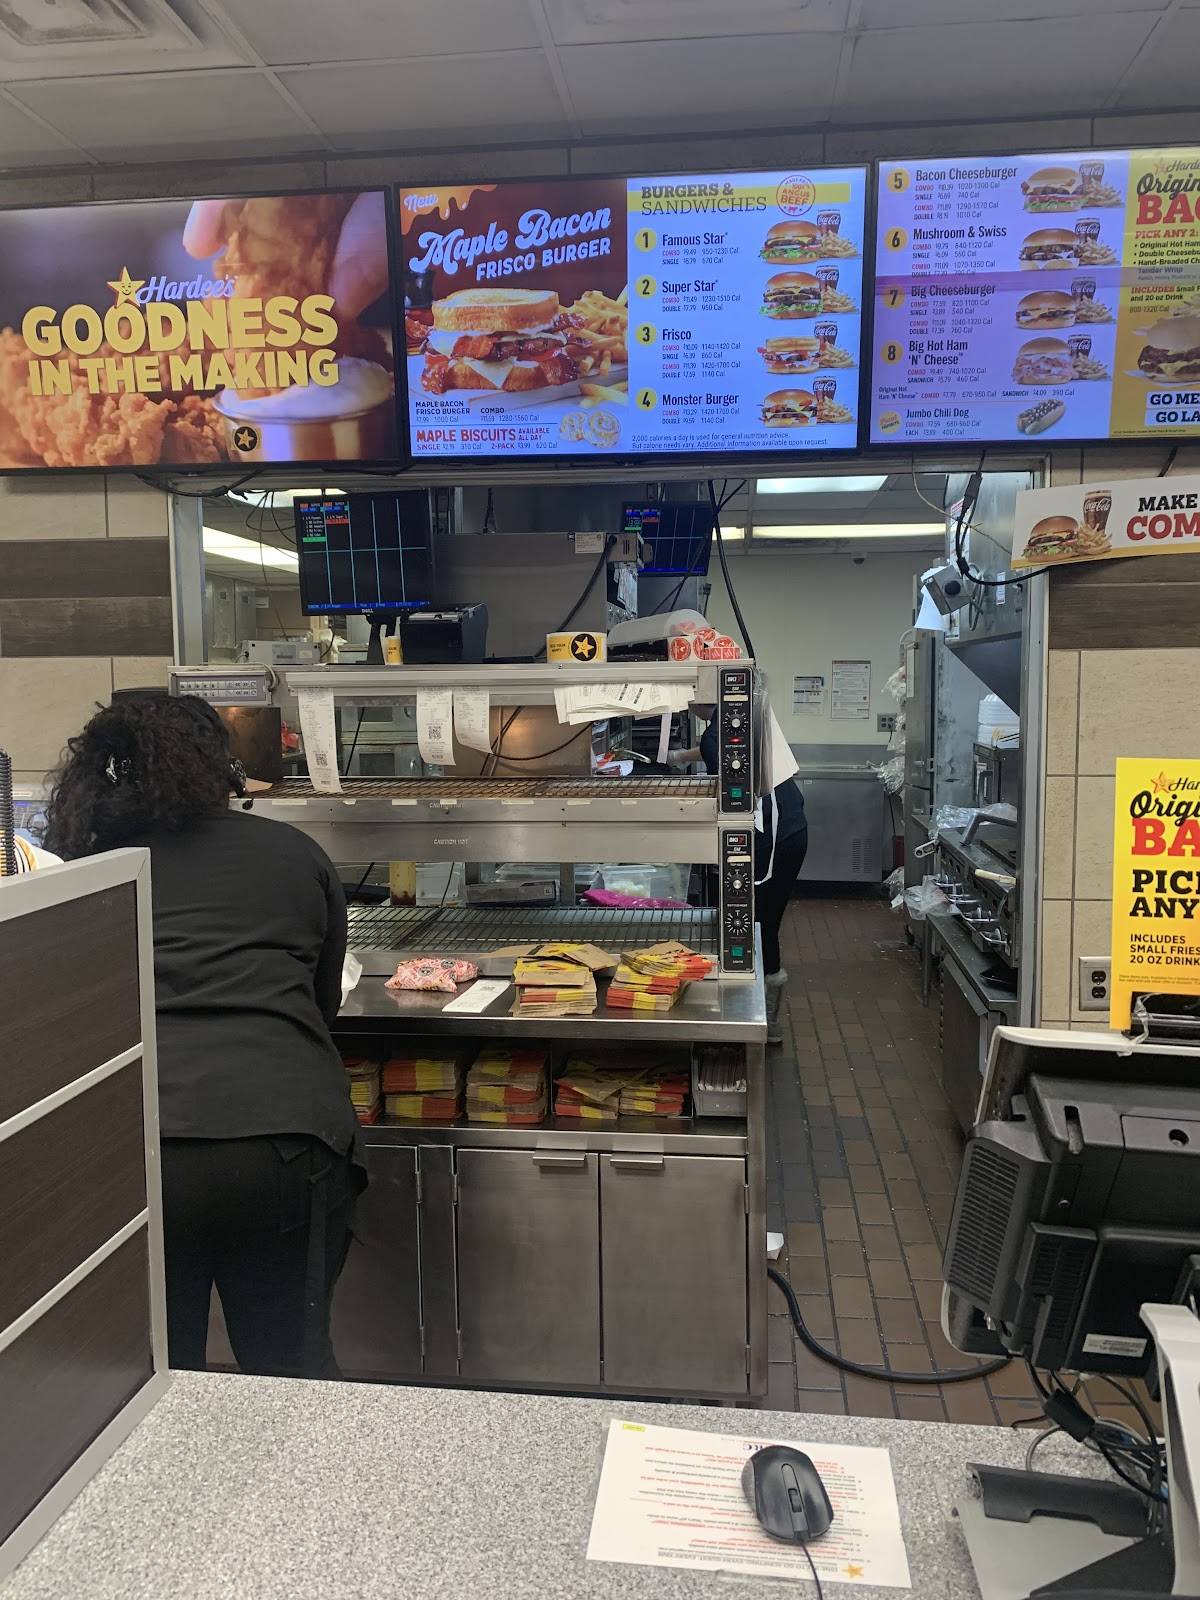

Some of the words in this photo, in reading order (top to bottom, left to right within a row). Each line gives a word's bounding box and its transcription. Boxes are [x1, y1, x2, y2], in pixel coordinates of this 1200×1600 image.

[894, 173, 902, 189] 5
[916, 170, 945, 181] Bacon
[949, 167, 1018, 180] Cheeseburger
[642, 184, 719, 198] BURGERS
[722, 183, 733, 195] &
[783, 189, 809, 197] ANGUS
[404, 194, 438, 212] New
[642, 197, 767, 215] SANDWICHES
[781, 194, 809, 205] BEEF
[1136, 193, 1200, 224] BA
[914, 228, 964, 239] Mushroom
[968, 226, 975, 237] &
[978, 225, 1006, 237] Swiss
[1136, 231, 1161, 239] PICK
[1164, 230, 1187, 238] ANY
[1189, 229, 1198, 237] 2:
[409, 221, 508, 274] Maple
[515, 207, 611, 249] Bacon
[643, 232, 648, 248] 1
[663, 235, 700, 246] Famous
[892, 232, 900, 247] 6
[1140, 241, 1168, 249] Original
[476, 253, 536, 281] FRISCO
[542, 237, 610, 267] BURGER
[136, 275, 235, 303] Hardee's
[643, 279, 650, 295] 2
[662, 281, 691, 294] Super
[911, 286, 926, 298] Big
[930, 284, 995, 296] Cheeseburger
[890, 290, 898, 305] 7
[22, 295, 338, 357] GOODNESS
[643, 327, 650, 342] 3
[663, 329, 691, 340] Frisco
[888, 345, 896, 360] 8
[910, 341, 924, 353] Big
[928, 340, 943, 351] Hot
[947, 340, 968, 350] Ham
[29, 359, 72, 396] IN
[80, 356, 162, 394] THE
[168, 349, 339, 391] MAKING
[643, 392, 650, 407] 4
[663, 394, 702, 405] Monster
[706, 394, 739, 406] Burger
[1150, 393, 1172, 405] GO
[906, 409, 931, 418] Jumbo
[934, 409, 951, 417] Chili
[954, 408, 968, 417] Dog
[1156, 411, 1178, 422] GO
[417, 430, 456, 442] MAPLE
[461, 429, 515, 441] BISCUITS
[1085, 498, 1111, 511] Coca-Cola
[1138, 494, 1198, 512] MAKE
[1132, 869, 1200, 894] PIC
[1130, 897, 1199, 919] ANY
[1130, 934, 1185, 944] INCLUDES
[1130, 945, 1167, 954] SMALL
[1171, 946, 1200, 955] FRIES
[1130, 955, 1143, 963] 20
[1148, 956, 1162, 964] OZ
[1166, 957, 1200, 965] DRINK
